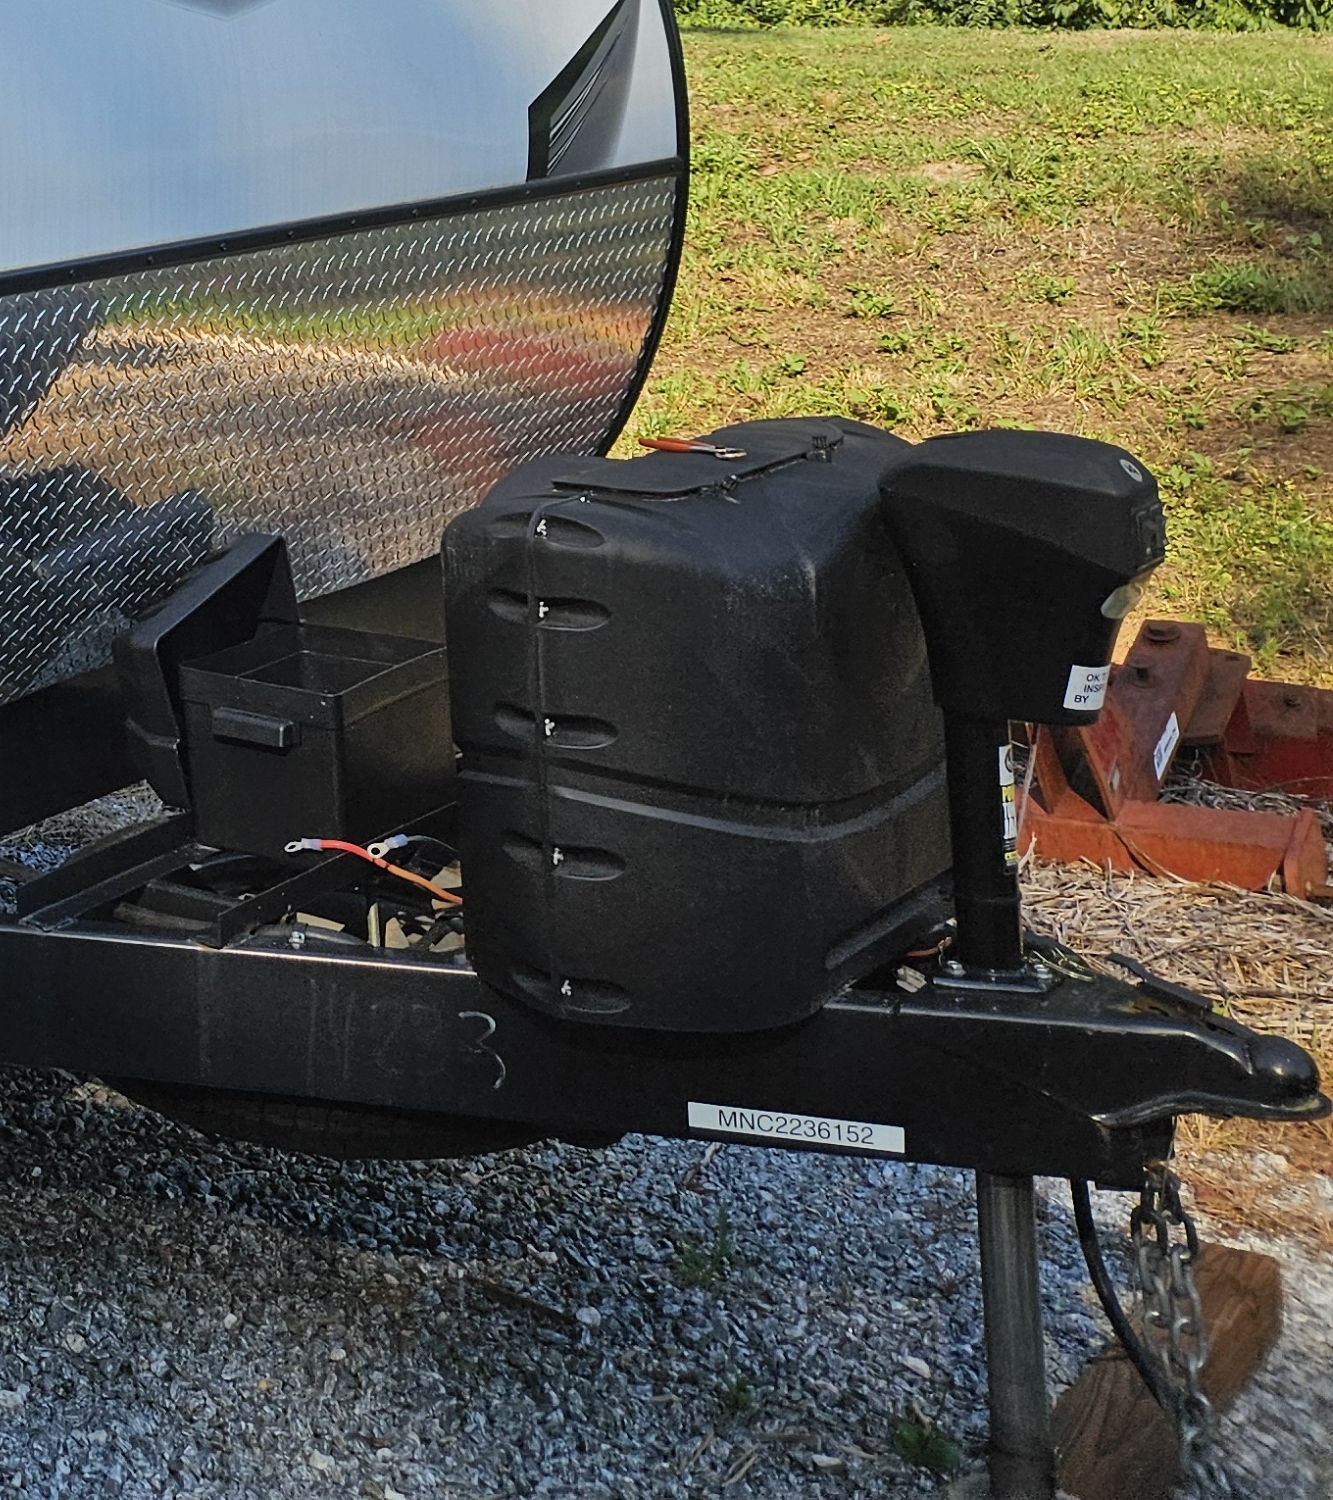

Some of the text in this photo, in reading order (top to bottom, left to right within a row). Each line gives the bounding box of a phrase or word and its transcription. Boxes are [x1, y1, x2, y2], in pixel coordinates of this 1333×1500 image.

[1086, 673, 1100, 682] OK
[1074, 694, 1089, 703] BY
[718, 1109, 875, 1145] MNC2236152
